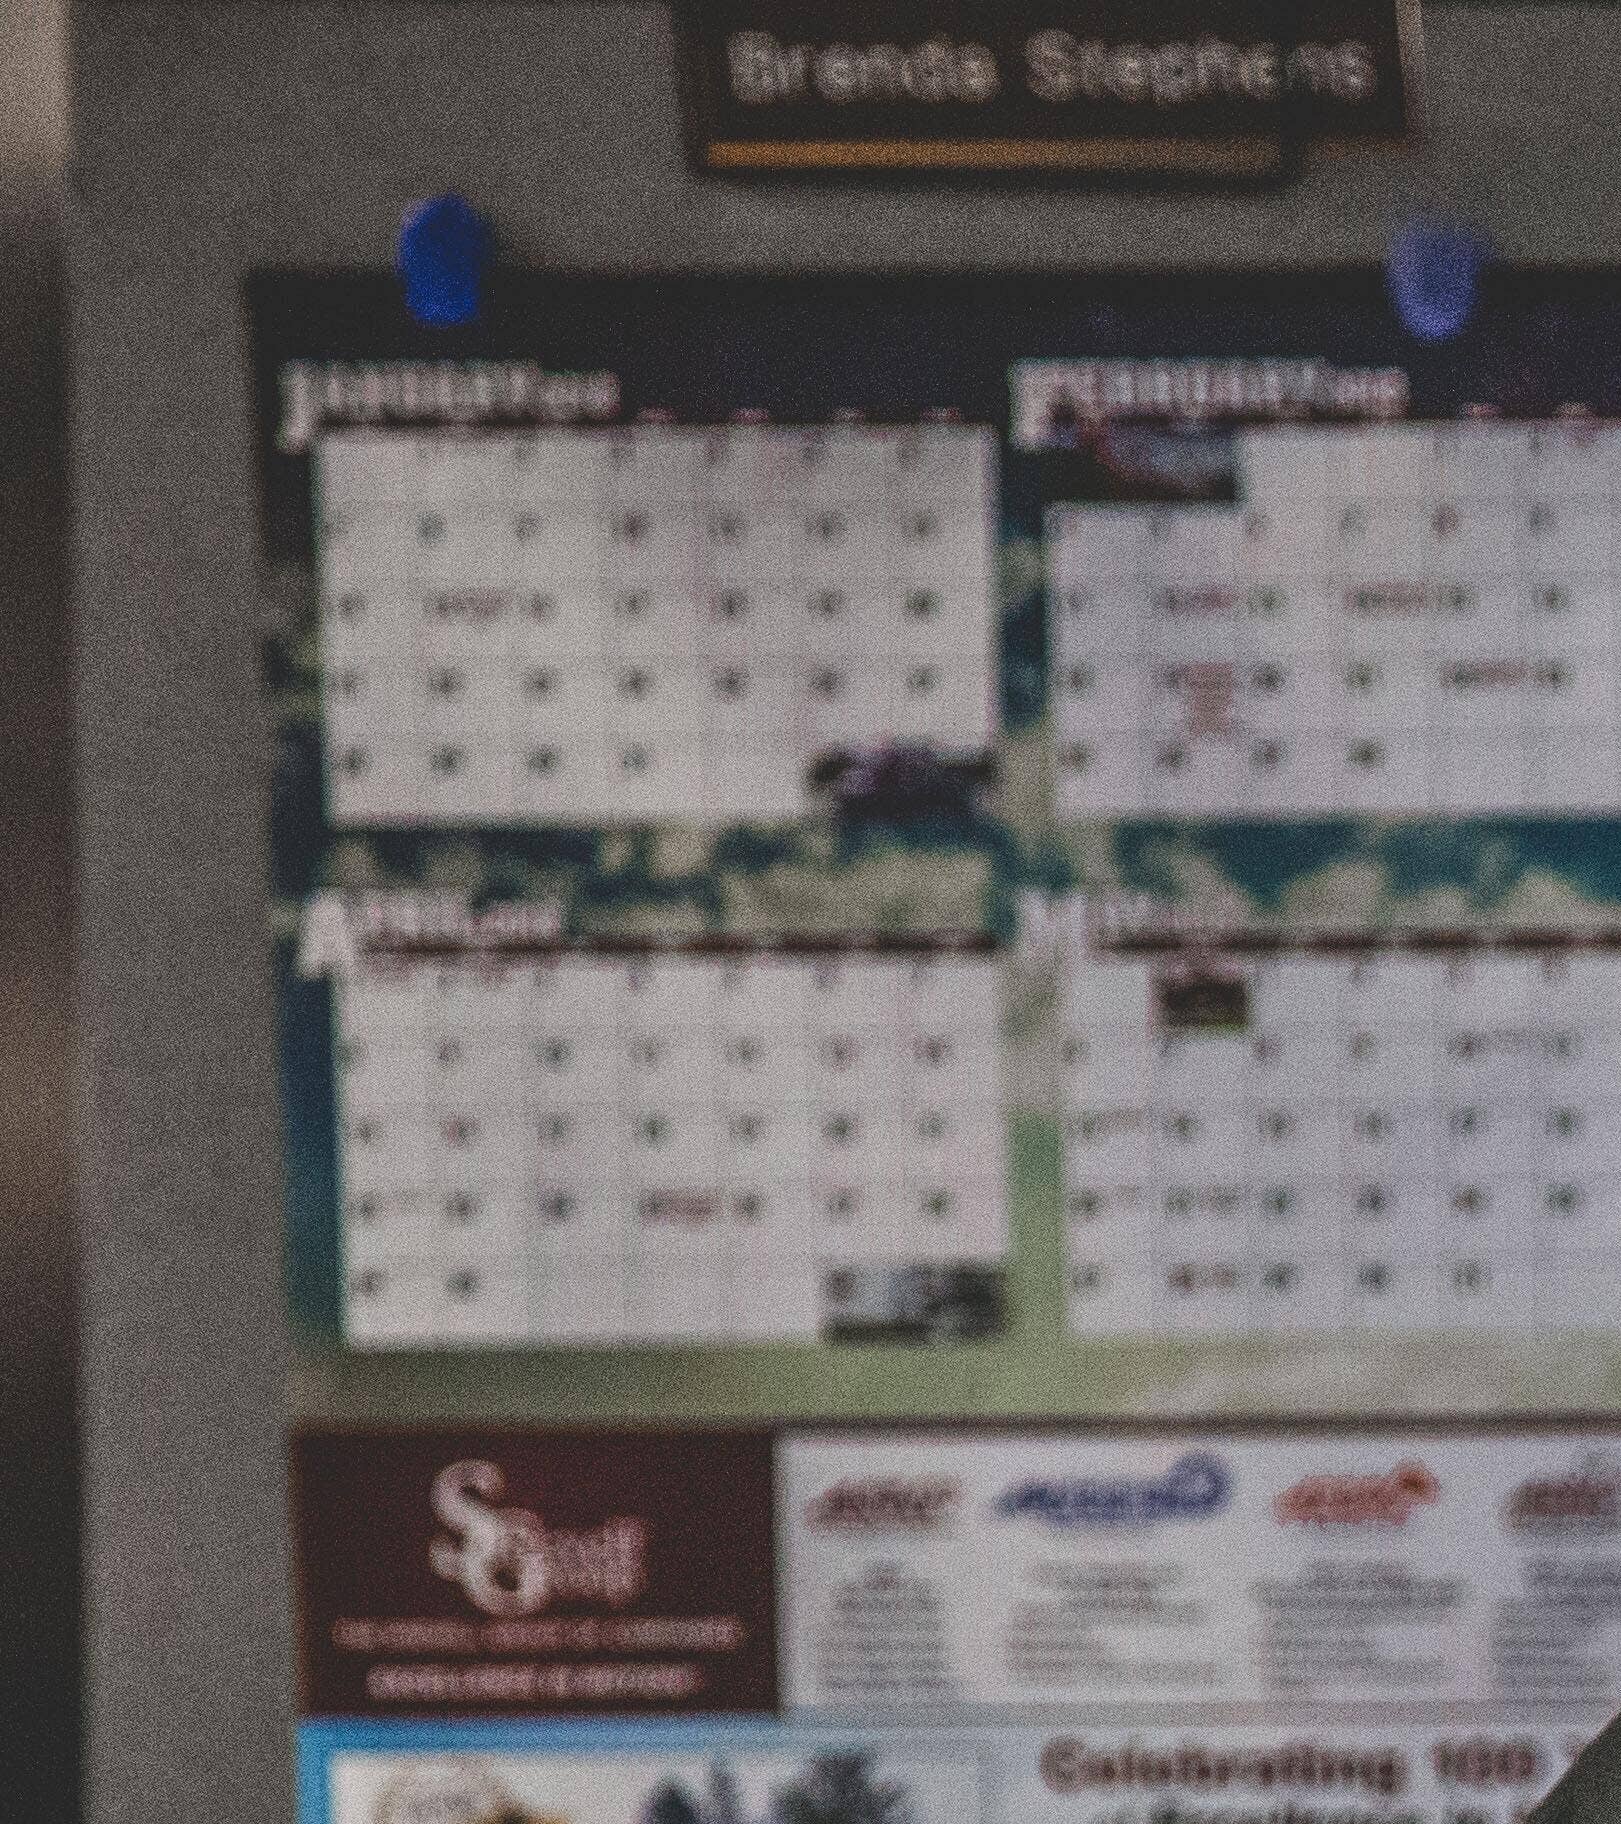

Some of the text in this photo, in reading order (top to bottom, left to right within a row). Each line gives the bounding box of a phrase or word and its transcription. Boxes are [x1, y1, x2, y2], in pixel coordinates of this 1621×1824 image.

[728, 28, 1378, 108] Brenda Stephens
[1040, 1737, 1406, 1795] Celebrating
